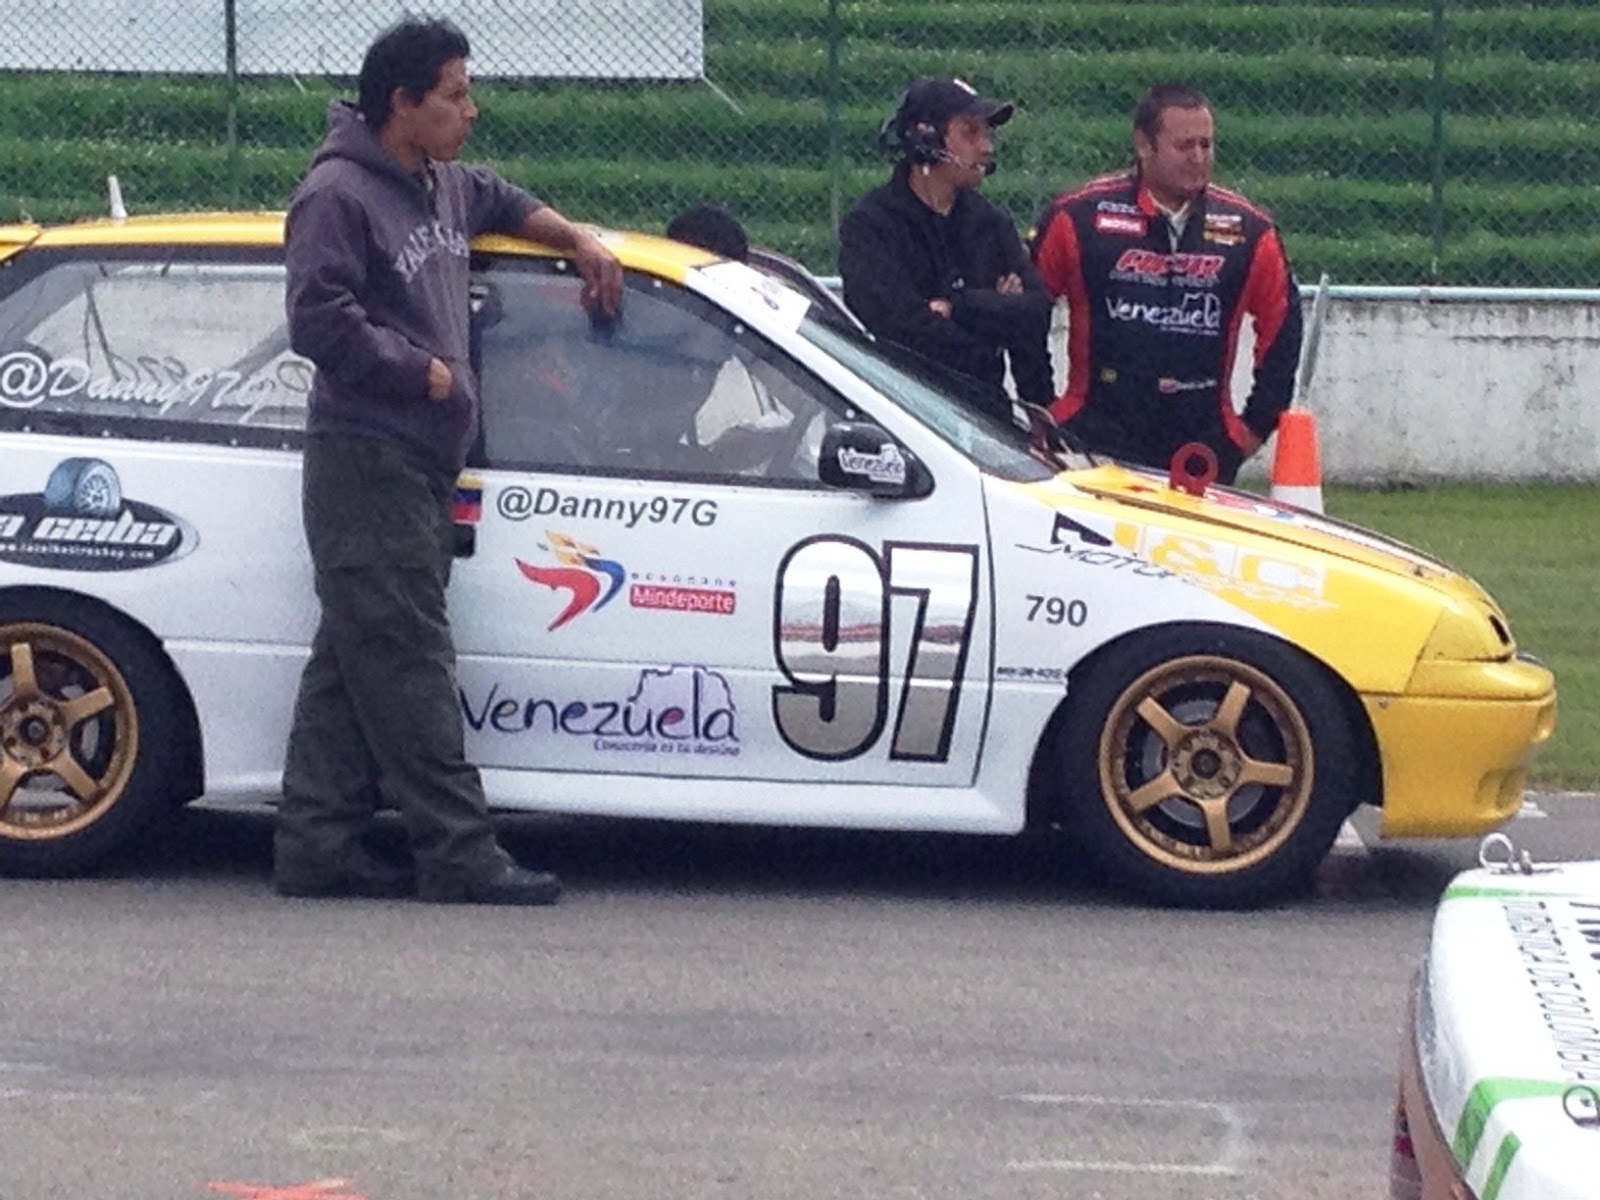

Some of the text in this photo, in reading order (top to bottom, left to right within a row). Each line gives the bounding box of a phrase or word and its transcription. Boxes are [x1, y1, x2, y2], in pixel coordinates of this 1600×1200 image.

[1105, 293, 1220, 328] Venezuela
[497, 486, 718, 528] @Danny97G
[632, 585, 734, 613] Mindeporte
[1026, 594, 1087, 627] 790
[772, 533, 979, 763] 97
[459, 669, 740, 742] Venezuela
